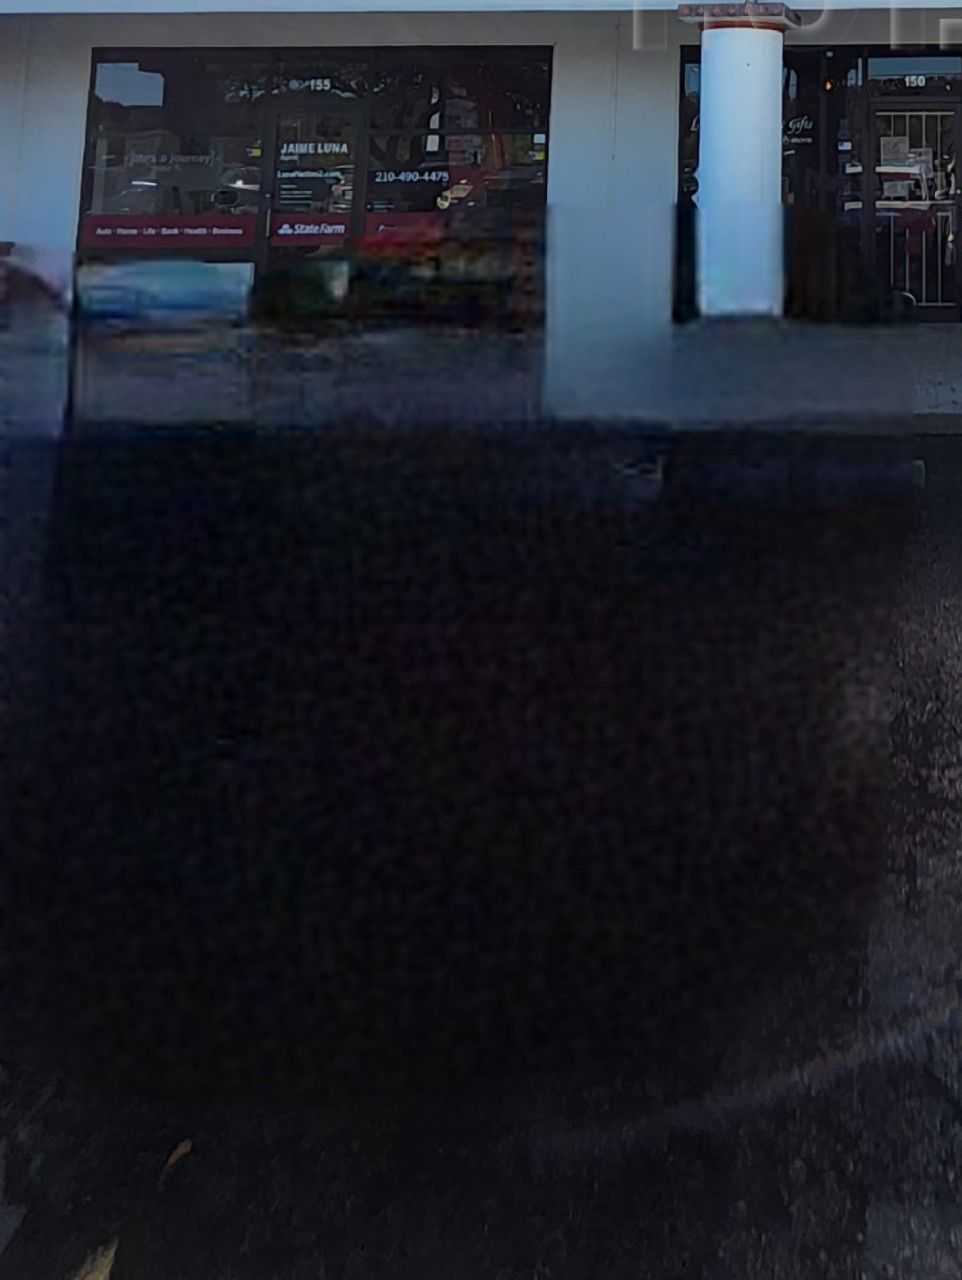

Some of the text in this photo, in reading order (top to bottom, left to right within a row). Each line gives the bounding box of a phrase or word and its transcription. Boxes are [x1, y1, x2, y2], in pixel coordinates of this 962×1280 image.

[310, 78, 331, 91] 155
[905, 75, 926, 87] 150
[280, 142, 349, 154] JAIME LUNA
